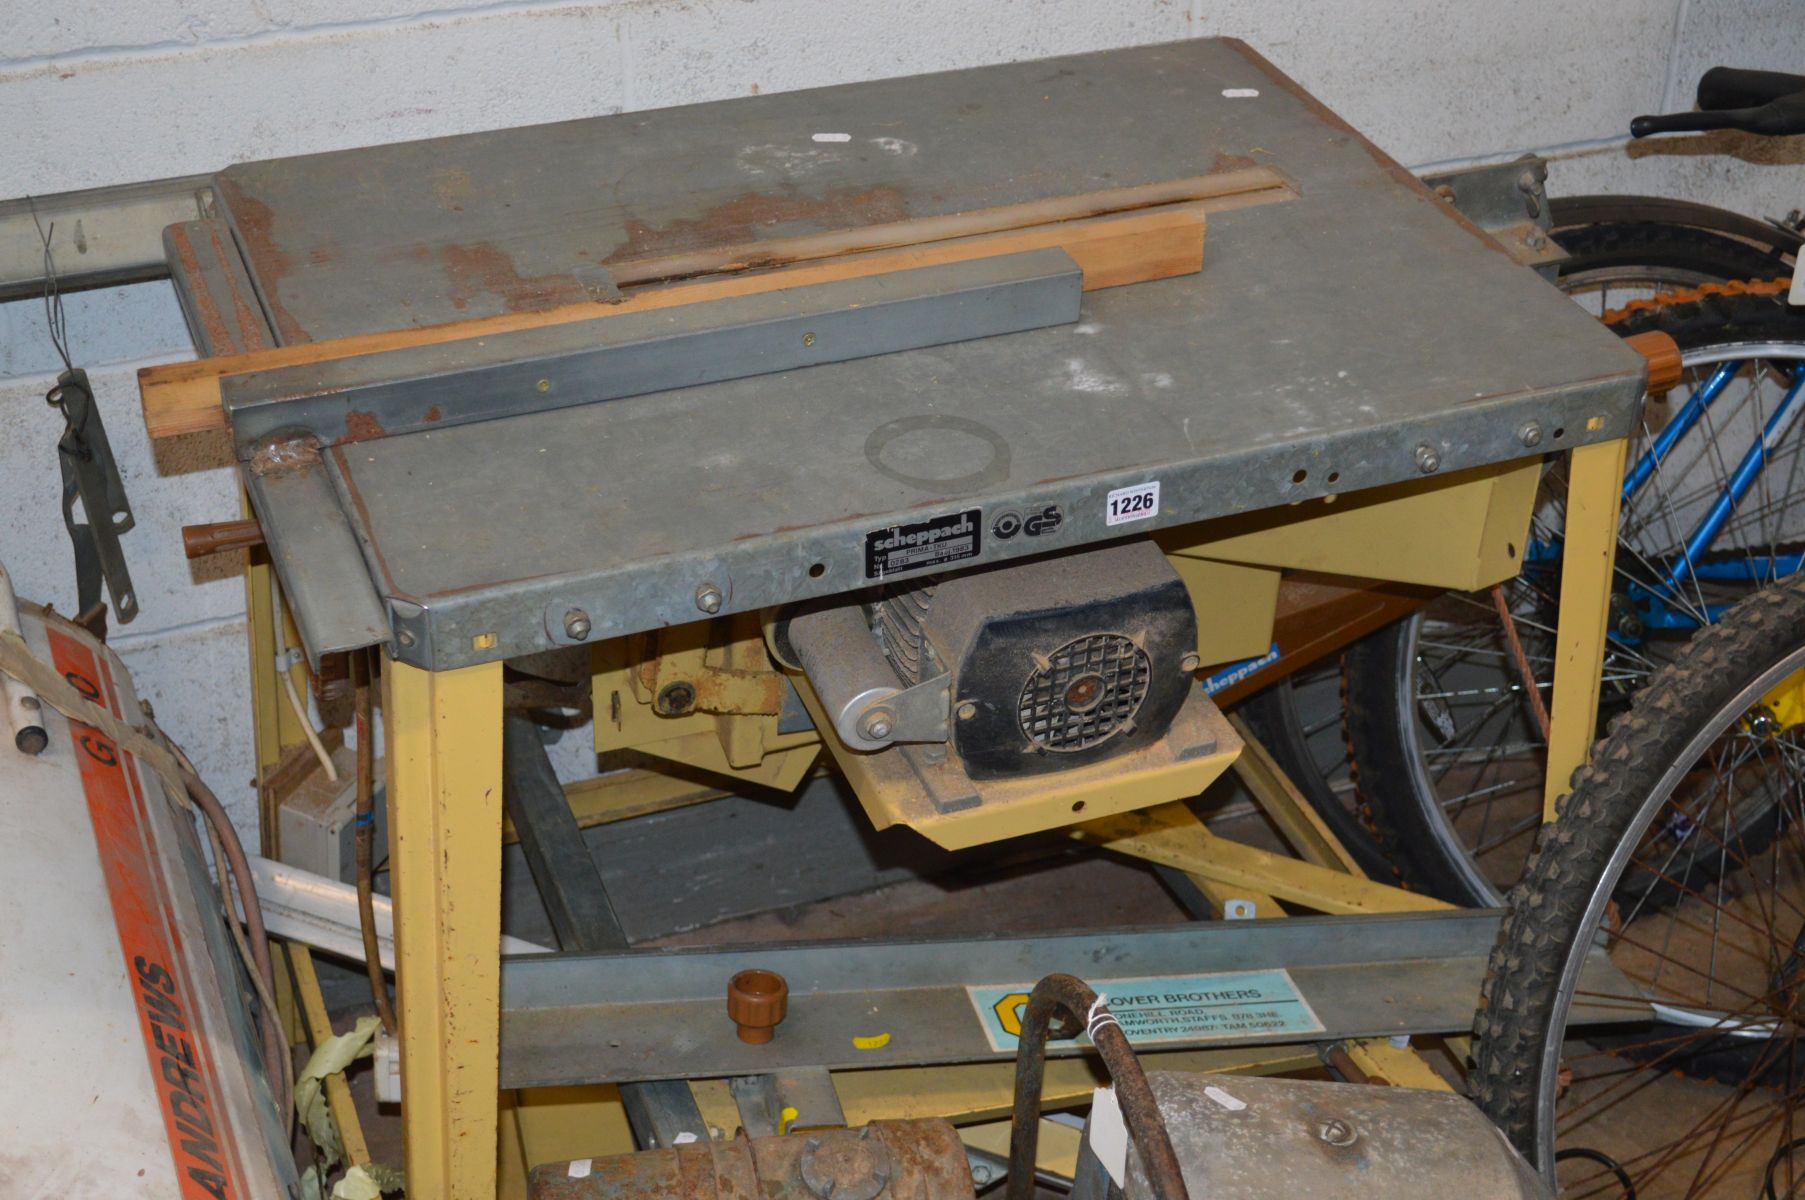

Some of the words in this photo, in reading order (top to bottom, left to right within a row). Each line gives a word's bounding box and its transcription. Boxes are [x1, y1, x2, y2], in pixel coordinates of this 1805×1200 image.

[1110, 492, 1154, 517] 1226
[873, 513, 974, 551] scheppach
[1106, 993, 1161, 1007] OVER
[1163, 988, 1262, 1004] BROTHERS
[133, 954, 230, 1200] ANDREWS
